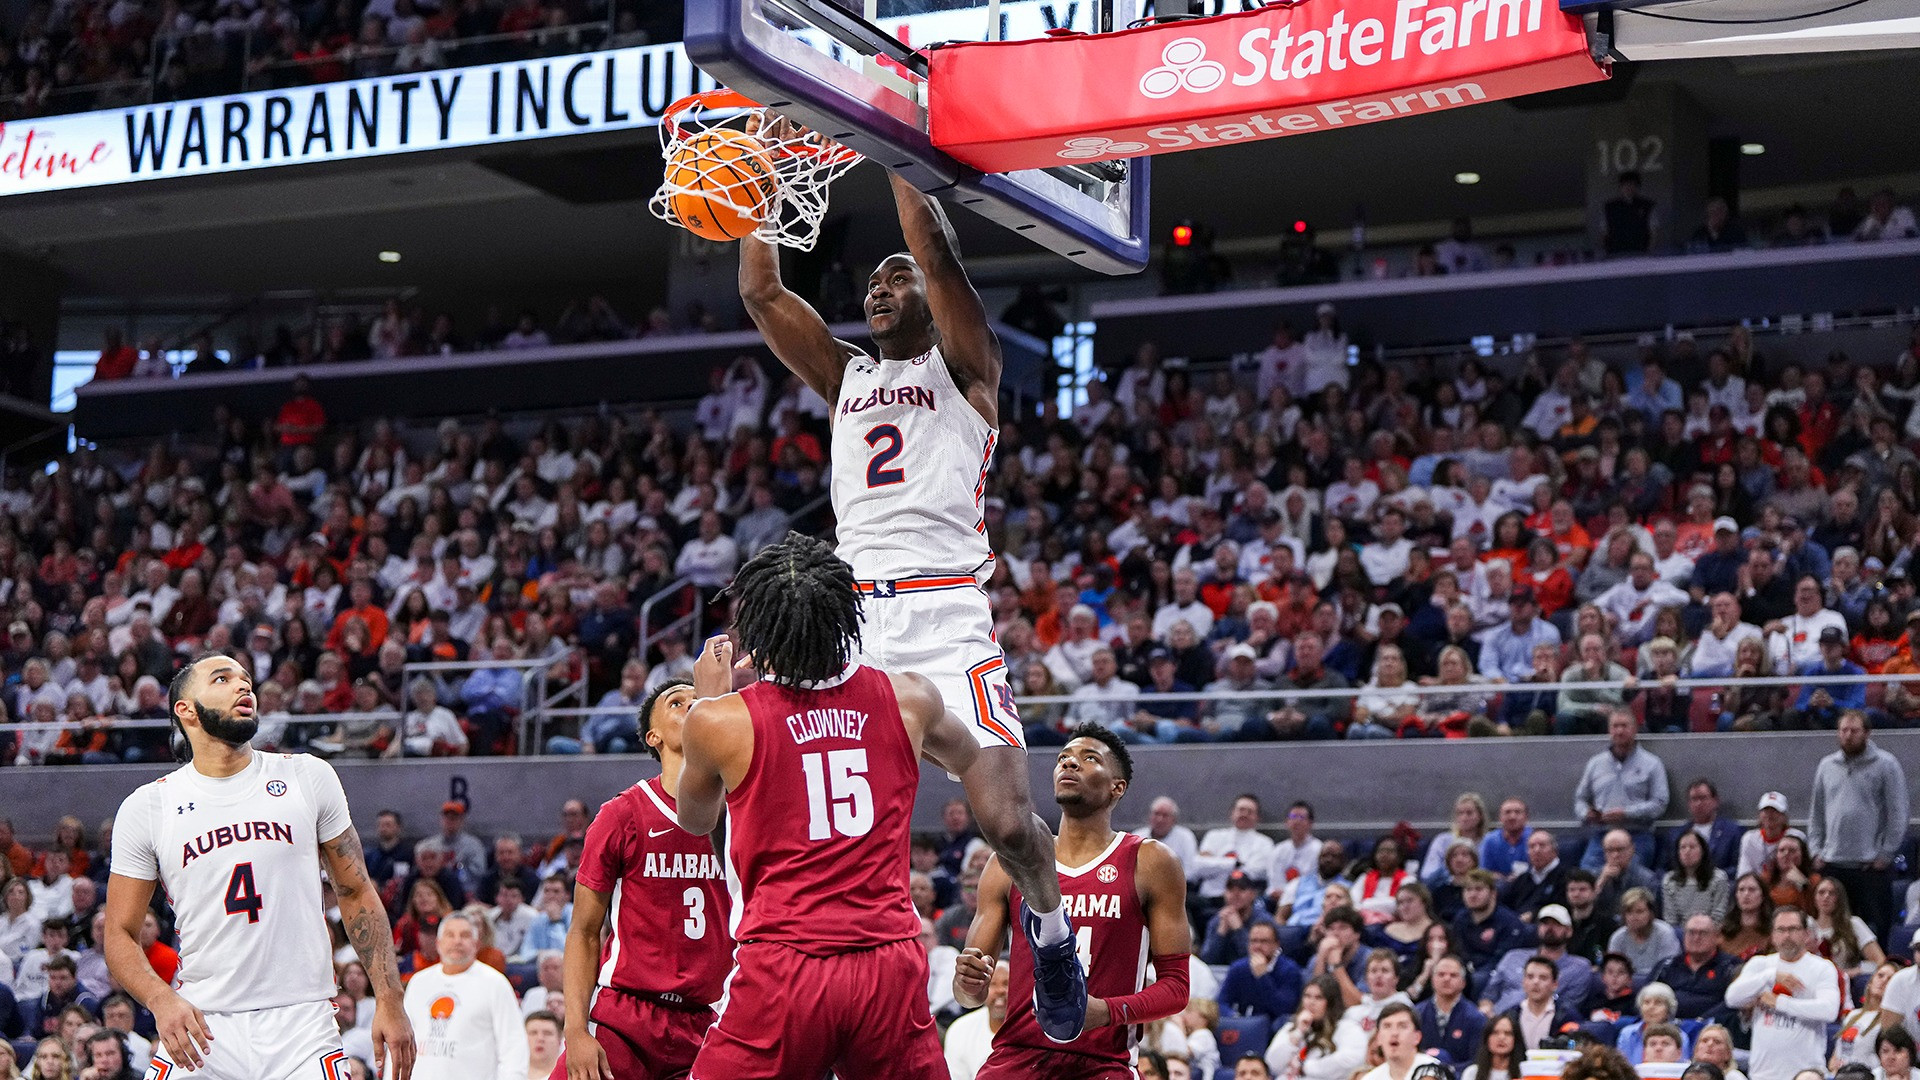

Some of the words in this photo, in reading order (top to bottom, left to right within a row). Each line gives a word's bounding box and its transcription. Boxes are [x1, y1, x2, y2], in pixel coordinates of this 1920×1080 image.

[1231, 9, 1384, 87] State
[1391, 0, 1542, 60] Farm
[0, 122, 112, 179] etime
[126, 75, 464, 173] WARRANTY
[1145, 114, 1317, 148] State
[1317, 82, 1487, 126] Farm
[1598, 136, 1663, 176] 102
[840, 386, 937, 422] AUBURN
[864, 423, 905, 489] 2
[786, 708, 868, 745] CLOWNEY
[267, 781, 287, 796] SEC
[801, 748, 875, 841] 15
[182, 821, 294, 869] AUBURN
[643, 852, 727, 880] ALABAM
[224, 861, 263, 924] 4
[1098, 864, 1117, 883] SEC
[683, 886, 706, 940] 3
[1061, 894, 1121, 919] BAMA
